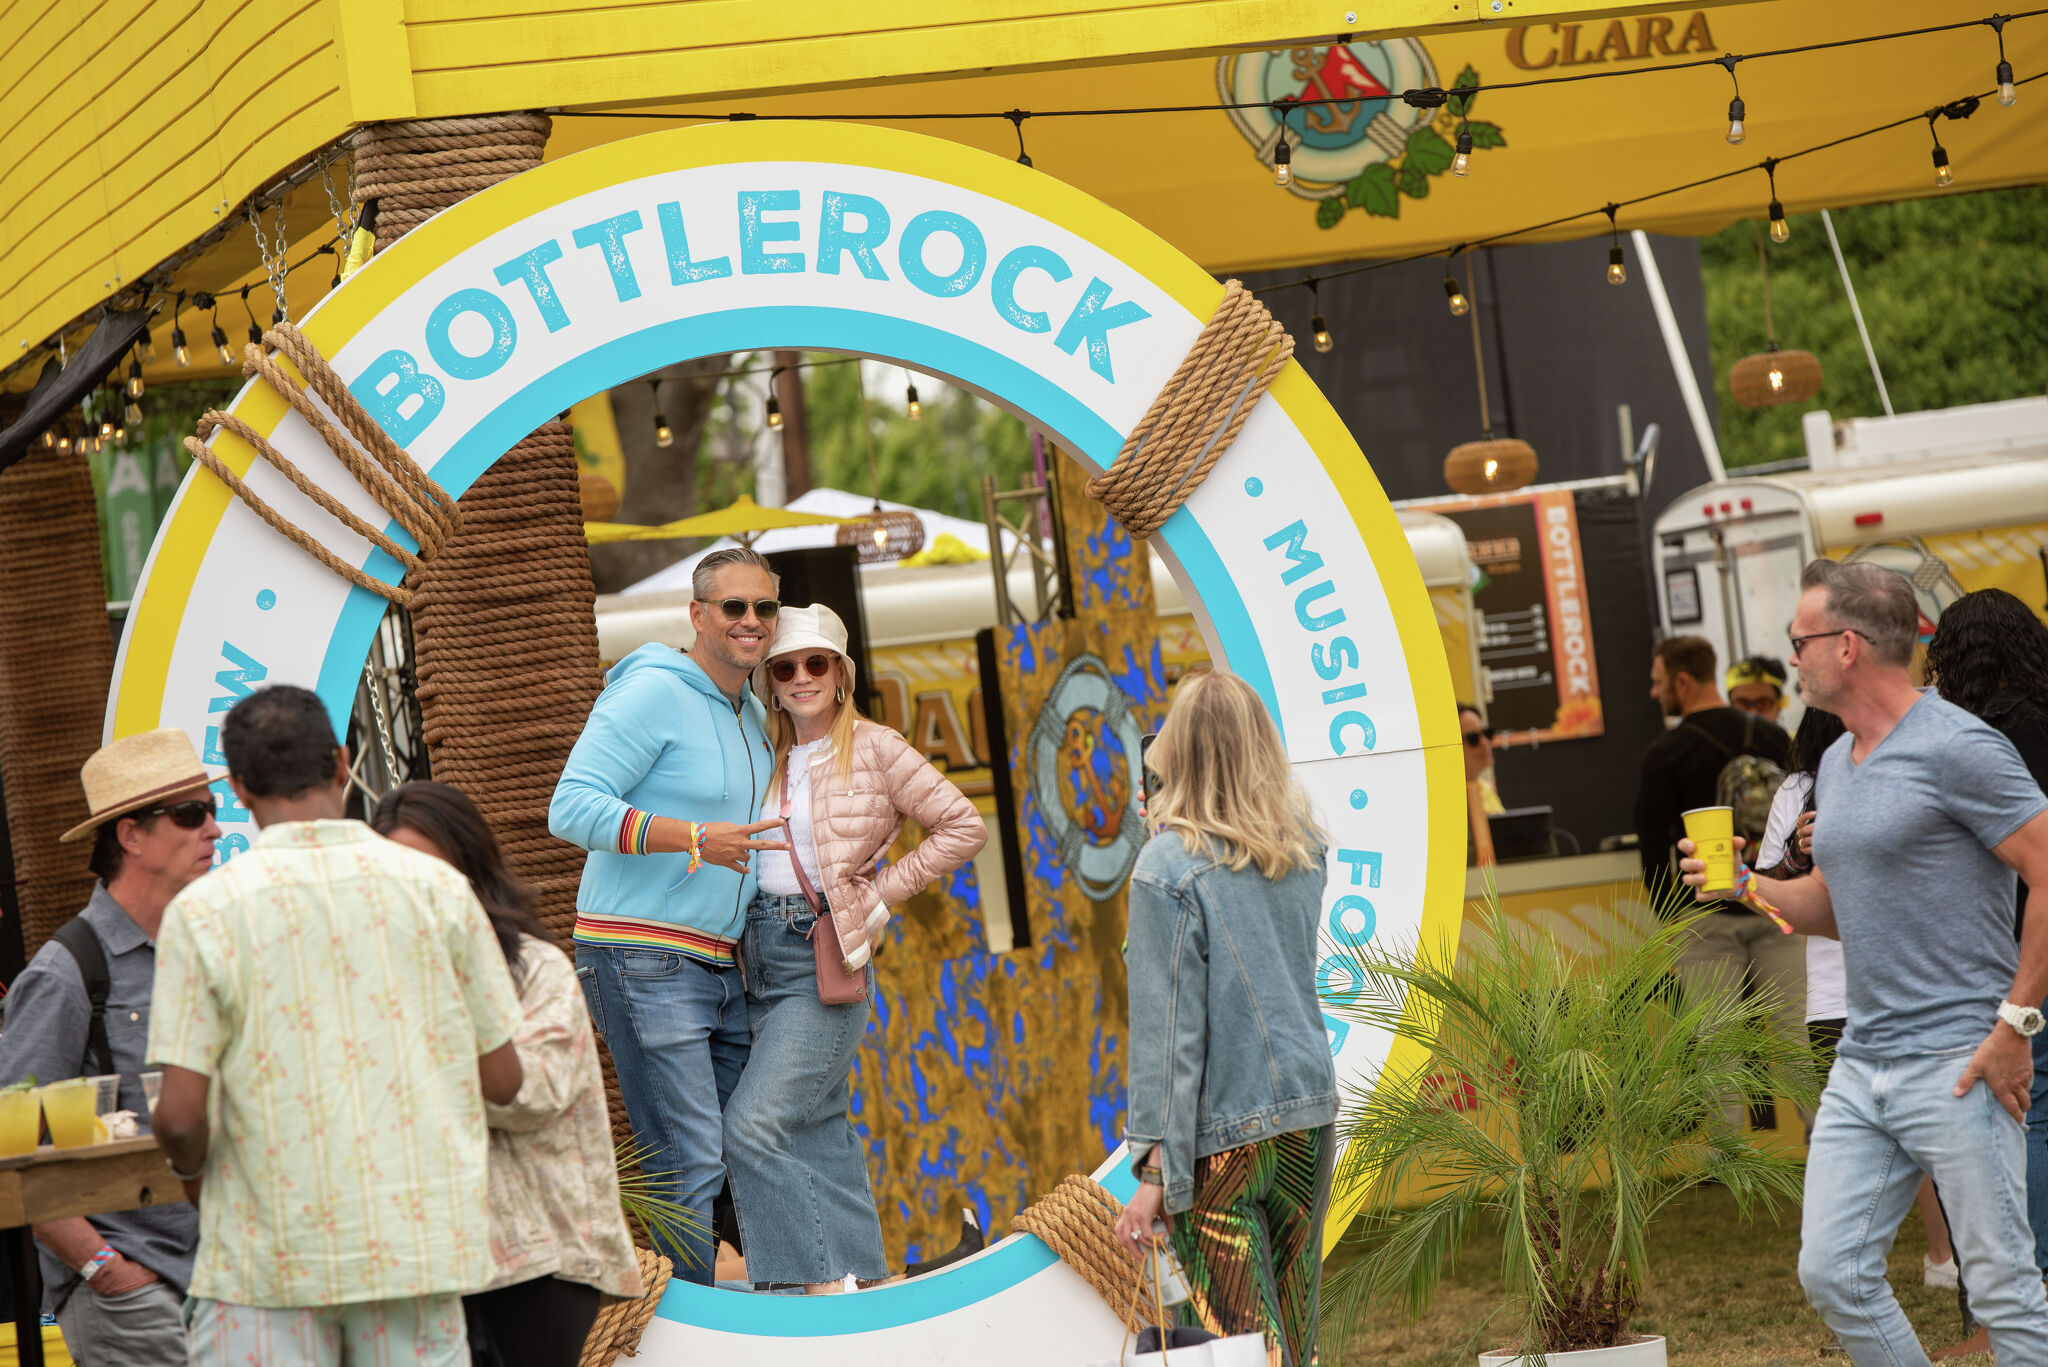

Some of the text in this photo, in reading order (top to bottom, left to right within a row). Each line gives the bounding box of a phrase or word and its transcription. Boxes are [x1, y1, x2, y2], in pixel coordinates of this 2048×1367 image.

[1506, 11, 1718, 70] CLARA
[347, 190, 1153, 450] BOTTLEROCK
[1263, 518, 1377, 757] MUSIC
[1546, 505, 1592, 695] BOTTLEROCK
